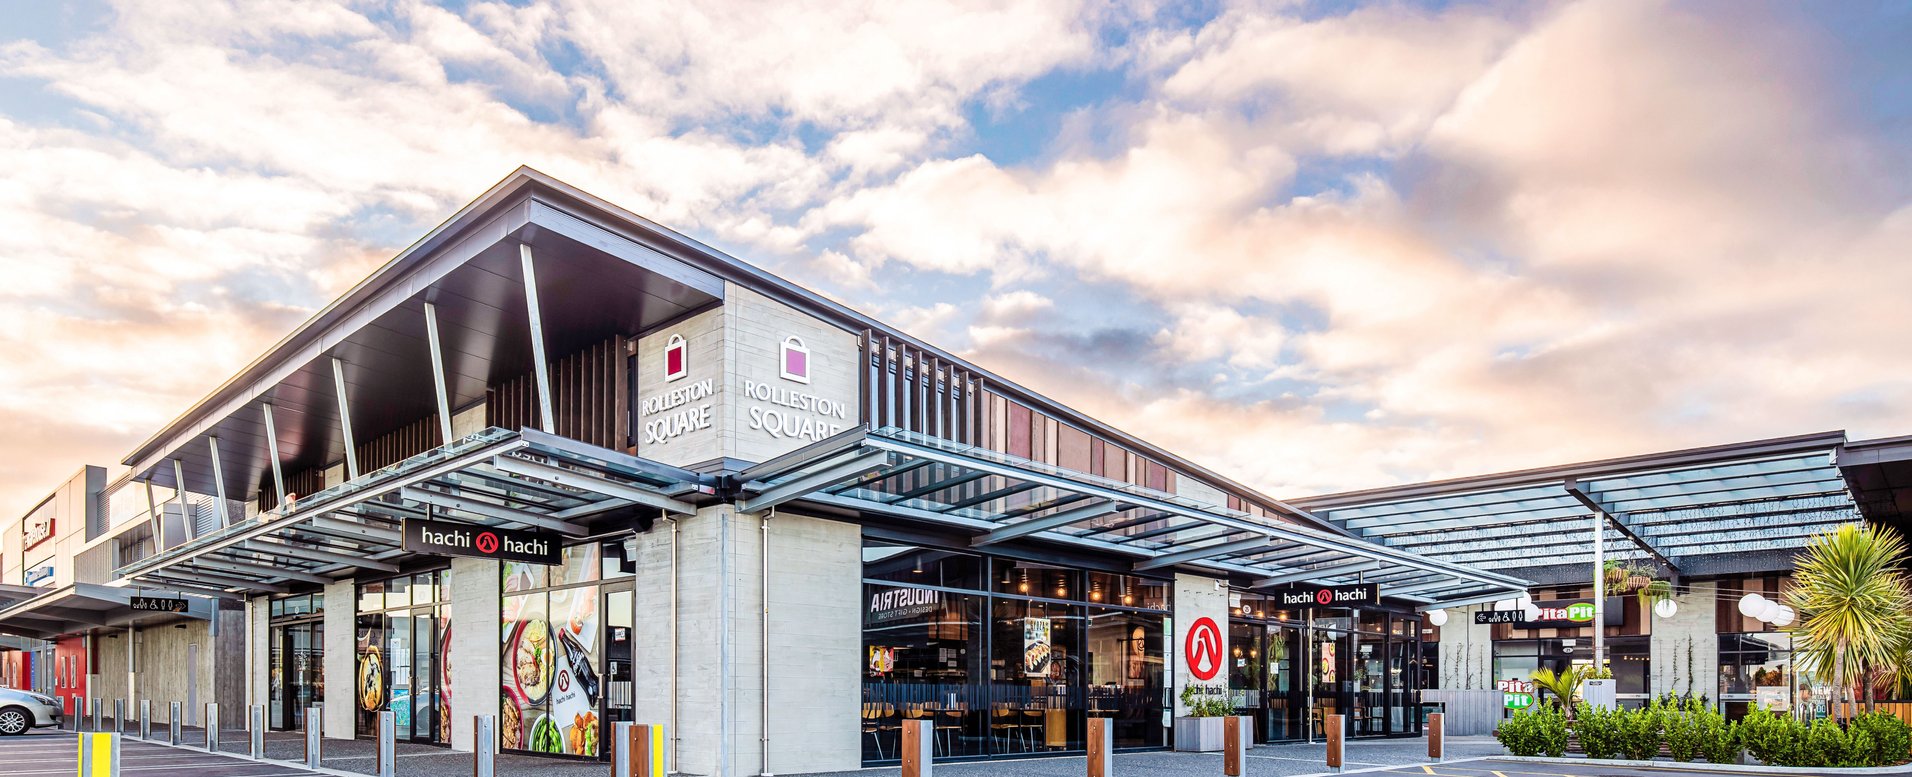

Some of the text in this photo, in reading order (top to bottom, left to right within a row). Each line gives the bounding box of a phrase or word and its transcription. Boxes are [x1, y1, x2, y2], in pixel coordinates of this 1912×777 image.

[642, 378, 713, 416] ROLLESTON
[745, 380, 845, 419] ROLLESTON
[645, 404, 711, 444] SQUARE
[422, 526, 548, 556] hachi hachi
[1284, 588, 1367, 604] hachi hachi
[1569, 607, 1593, 618] Pit
[1205, 684, 1222, 694] hachi
[1497, 681, 1533, 693] Pita
[1503, 694, 1529, 706] Pit
